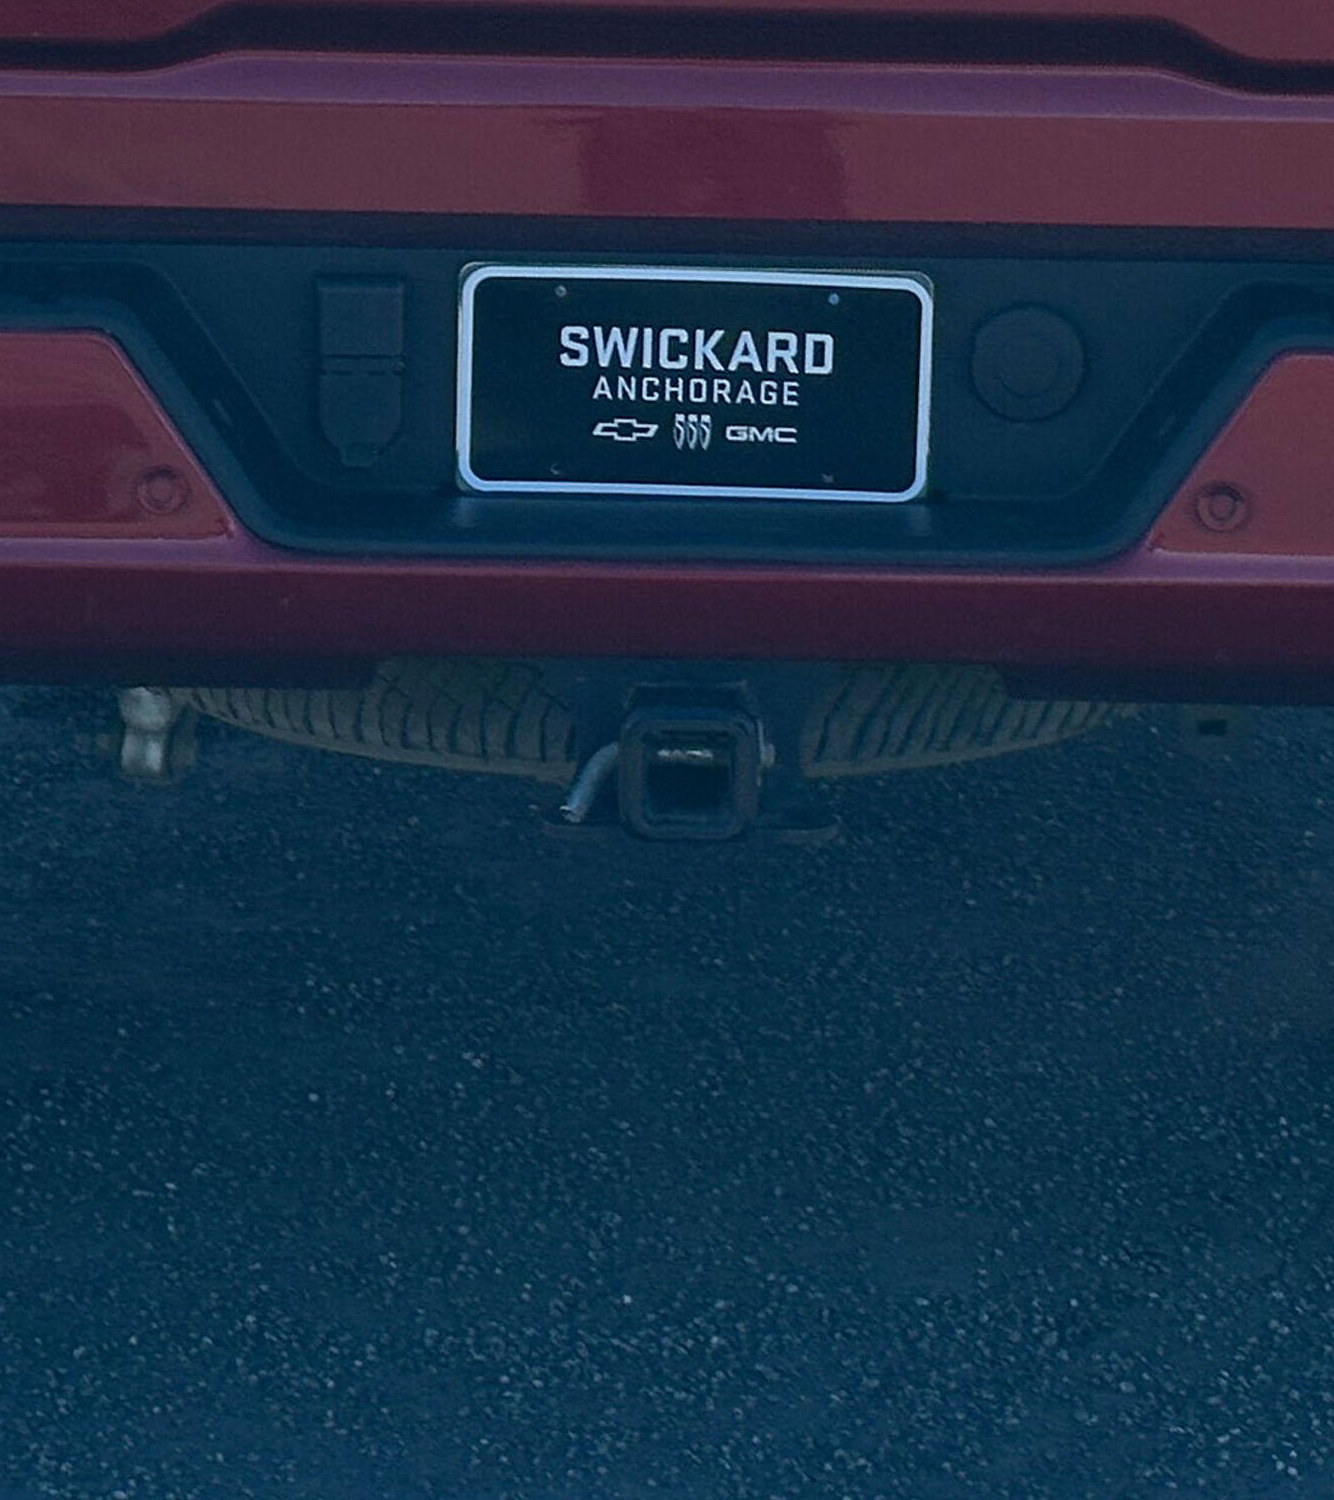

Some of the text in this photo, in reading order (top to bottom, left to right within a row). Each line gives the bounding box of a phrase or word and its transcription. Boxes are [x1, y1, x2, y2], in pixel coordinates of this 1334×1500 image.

[559, 325, 834, 375] SWICKARD
[592, 375, 800, 407] ANCHORAGE
[725, 425, 798, 444] GMC
